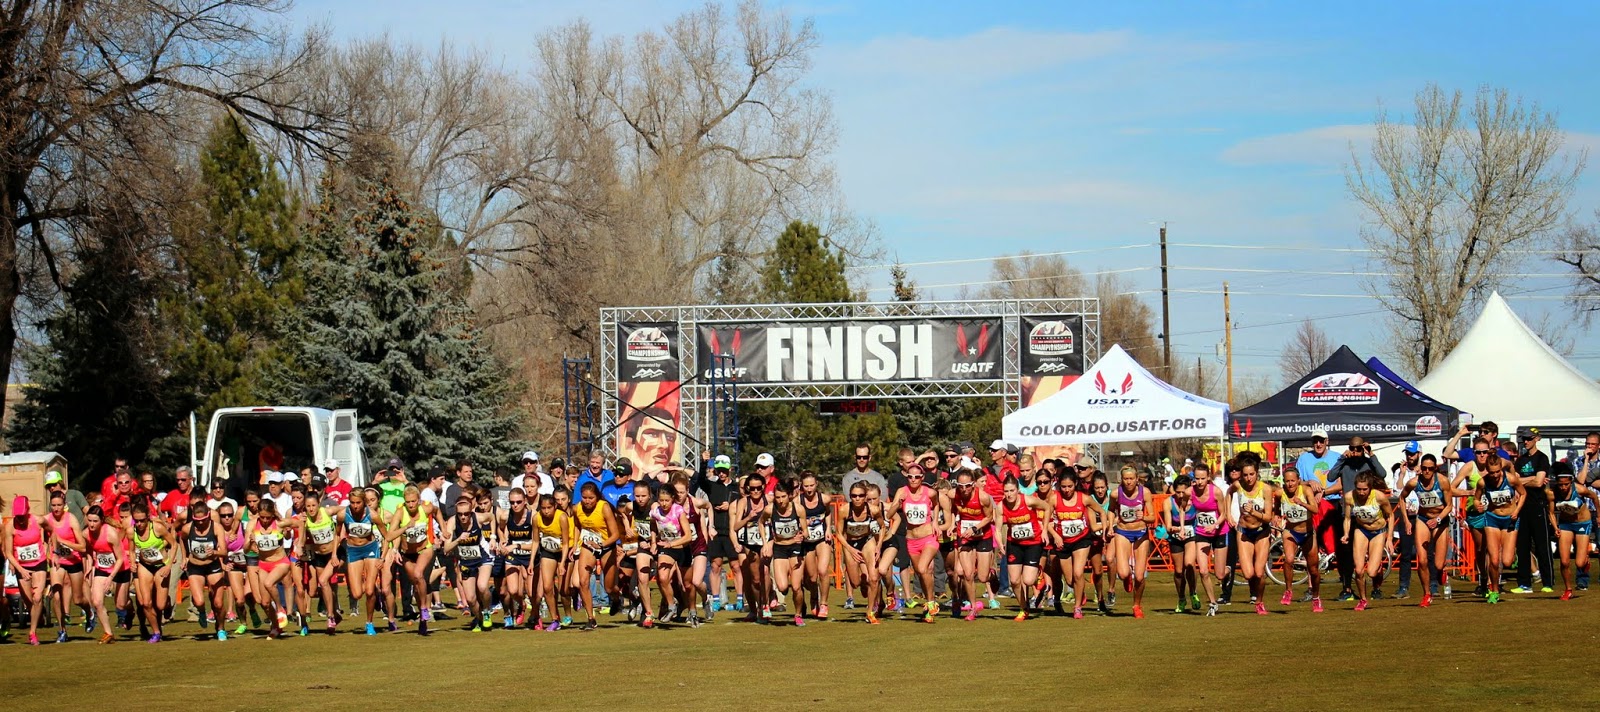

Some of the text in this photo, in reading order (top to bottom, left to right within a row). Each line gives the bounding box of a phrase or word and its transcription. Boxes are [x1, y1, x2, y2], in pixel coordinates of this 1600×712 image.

[767, 324, 933, 381] FINISH
[951, 362, 995, 374] USATF
[1020, 417, 1207, 436] COLORADO.USATF.ORG
[1267, 423, 1408, 433] www.boulderusacross.com
[1420, 497, 1437, 506] 677
[906, 510, 925, 519] 698
[1286, 509, 1303, 519] 687
[1198, 516, 1215, 524] 646
[407, 527, 426, 539] 668
[779, 524, 796, 534] 703
[1013, 528, 1031, 538] 697
[1064, 525, 1083, 534] 705
[313, 530, 331, 541] 634
[258, 539, 276, 548] 641
[19, 550, 39, 560] 658
[460, 548, 478, 557] 690
[98, 556, 115, 566] 686
